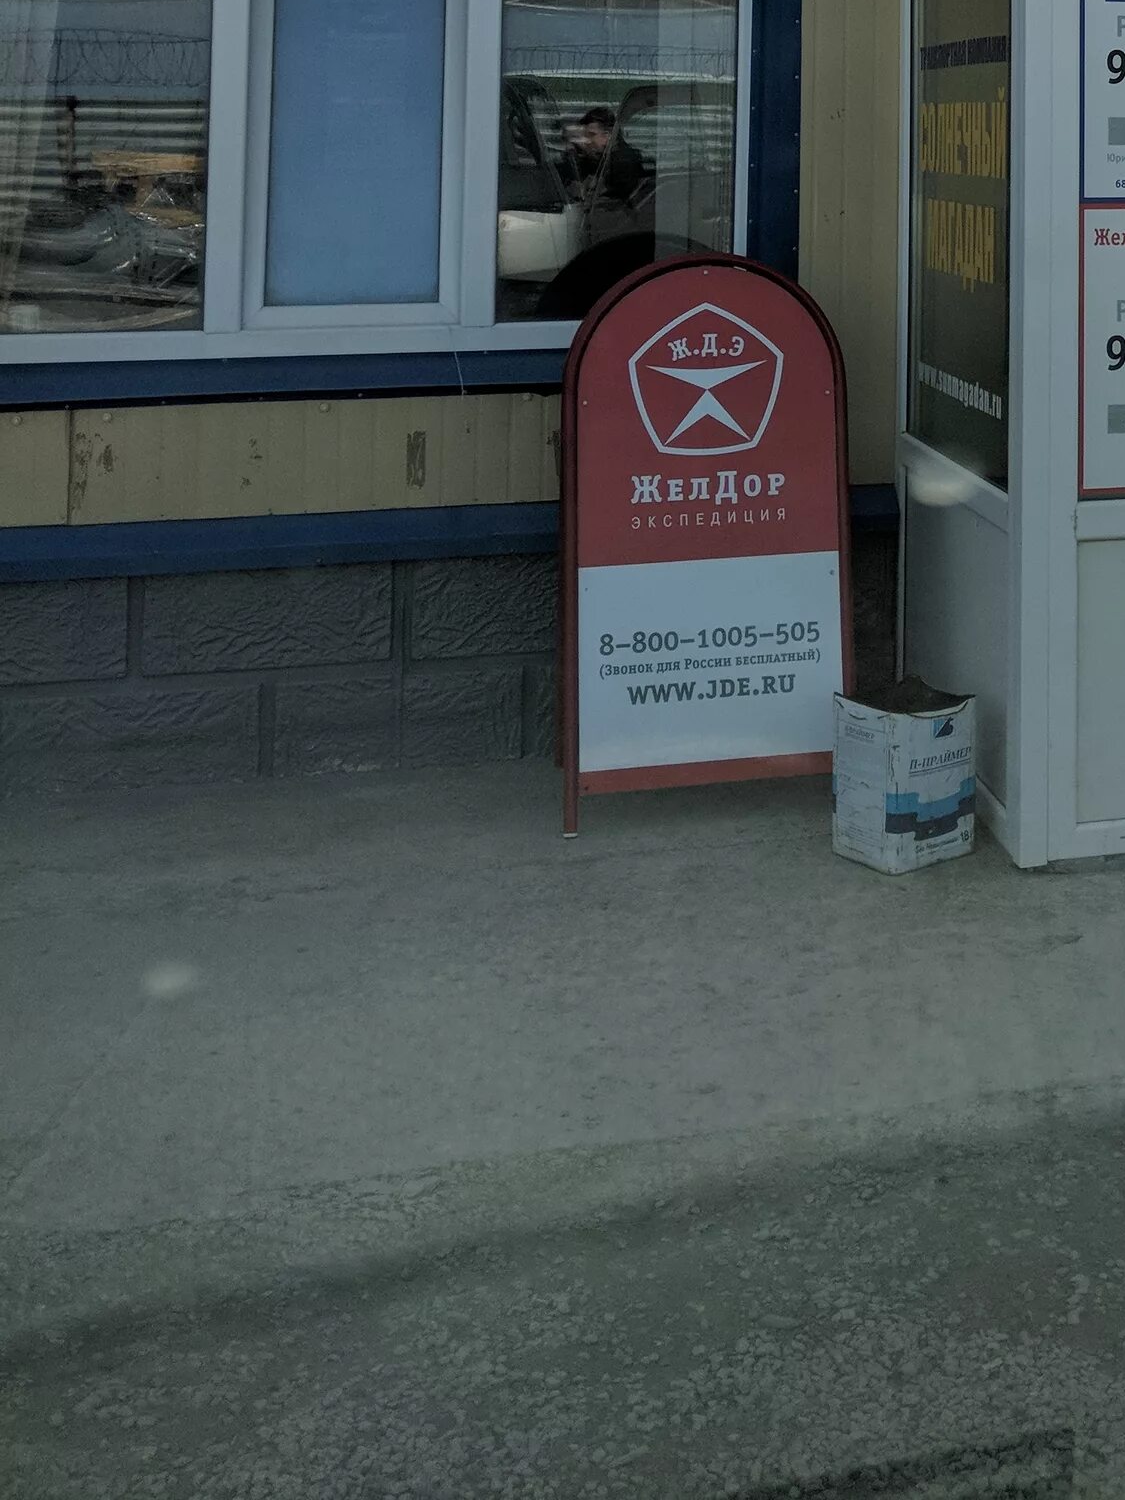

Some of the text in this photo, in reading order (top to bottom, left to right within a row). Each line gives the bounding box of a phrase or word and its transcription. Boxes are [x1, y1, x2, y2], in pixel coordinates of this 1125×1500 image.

[919, 86, 1006, 179] СОЛНЕЧНЫЙ
[927, 198, 995, 293] МАГАДАН
[631, 507, 786, 530] ЭКСПЕДИЦИЯ
[627, 674, 796, 705] WWW.JDE.RU
